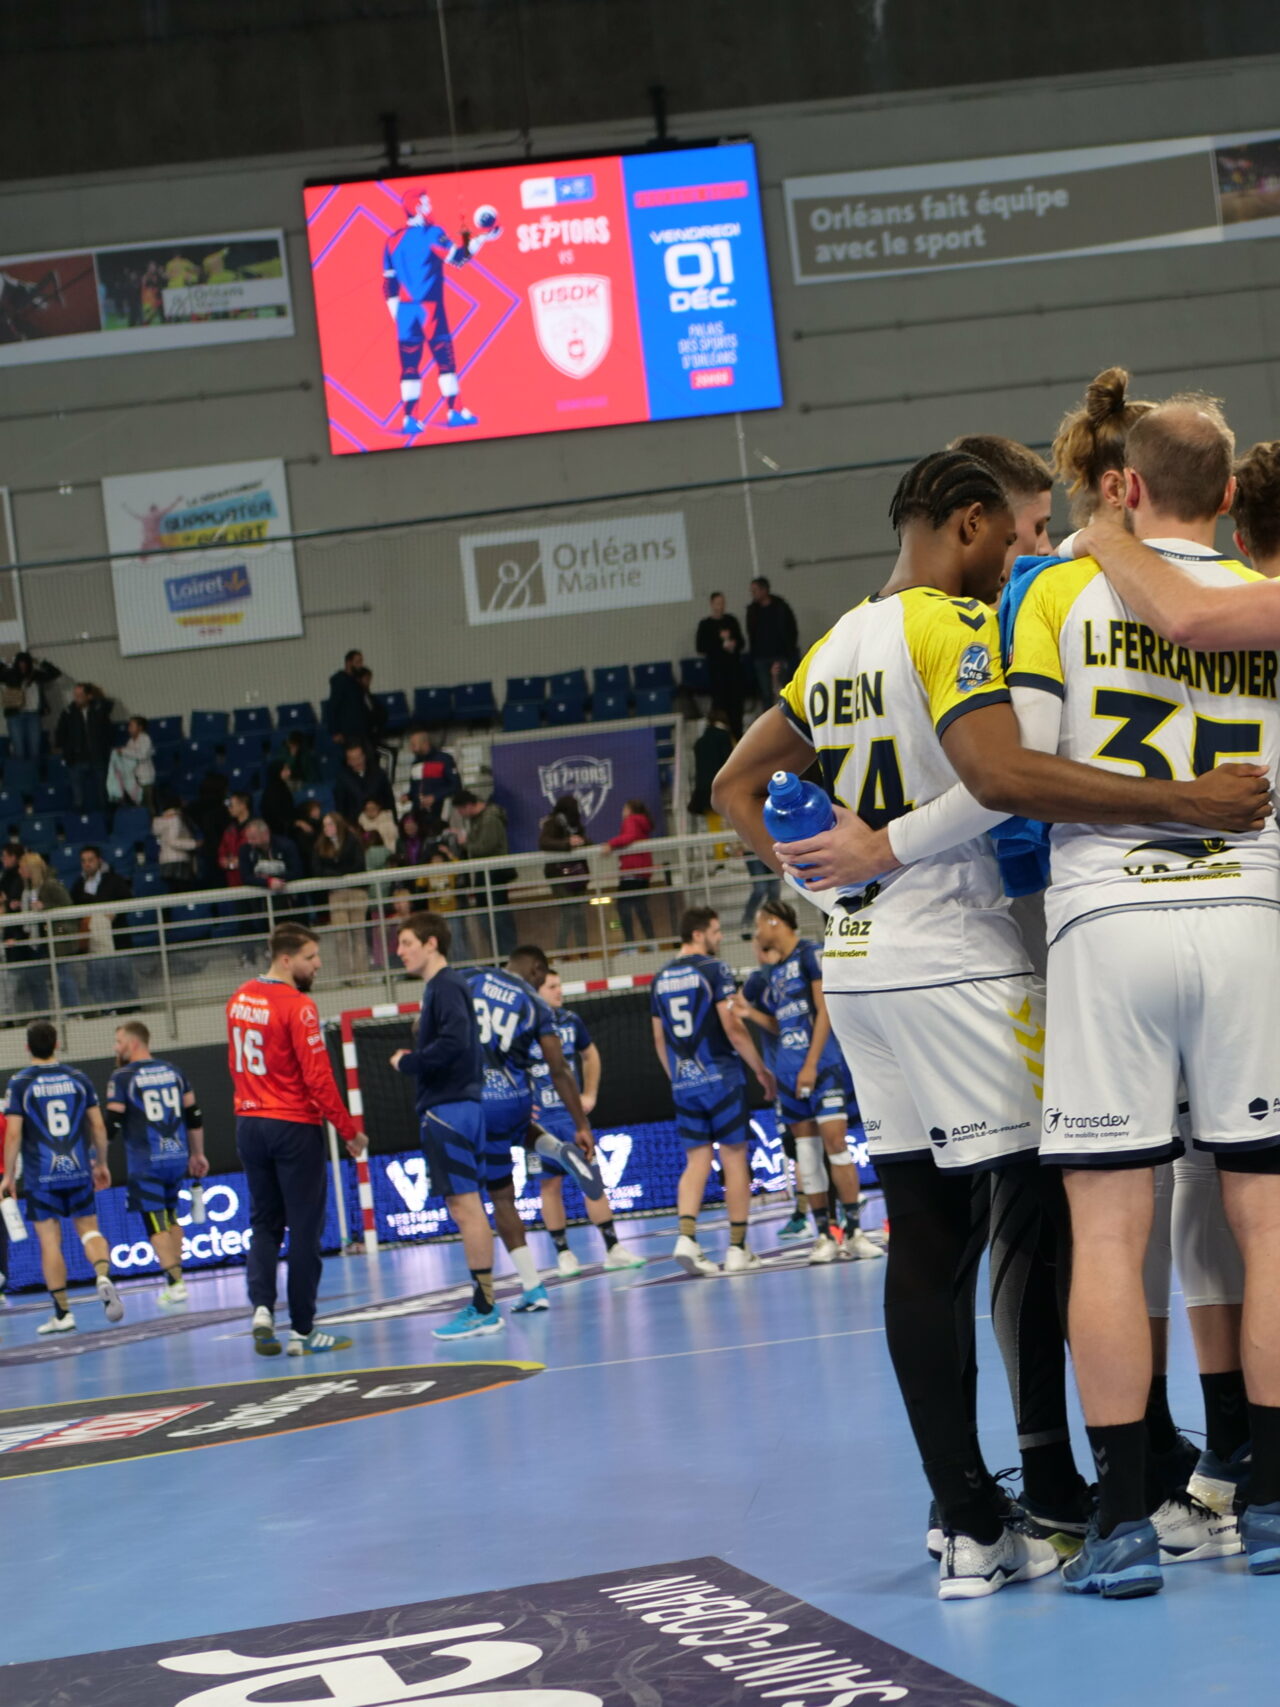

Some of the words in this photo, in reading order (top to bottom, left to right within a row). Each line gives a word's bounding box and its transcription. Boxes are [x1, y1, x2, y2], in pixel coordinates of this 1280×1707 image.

[810, 202, 915, 232] Orléans
[921, 194, 968, 222] fait
[975, 185, 1069, 220] équipe
[815, 233, 877, 263] avec
[882, 231, 910, 255] le
[914, 223, 987, 258] sport
[664, 238, 735, 289] 01
[669, 286, 737, 313] DÉC.
[553, 535, 677, 571] Orléans
[169, 575, 225, 600] Loiret
[557, 566, 641, 594] Mairie
[961, 651, 989, 678] 60
[838, 916, 873, 937] Gaz
[473, 998, 520, 1053] 34
[669, 996, 693, 1038] 5
[233, 1026, 267, 1076] 16
[47, 1100, 70, 1137] 6
[142, 1086, 182, 1122] 64
[1063, 1112, 1130, 1129] transdev
[951, 1121, 987, 1137] ADIM
[1064, 1131, 1073, 1139] the
[1075, 1130, 1098, 1140] mobility
[1100, 1131, 1130, 1140] company
[599, 1575, 910, 1707] SAINT-GOBAIN
